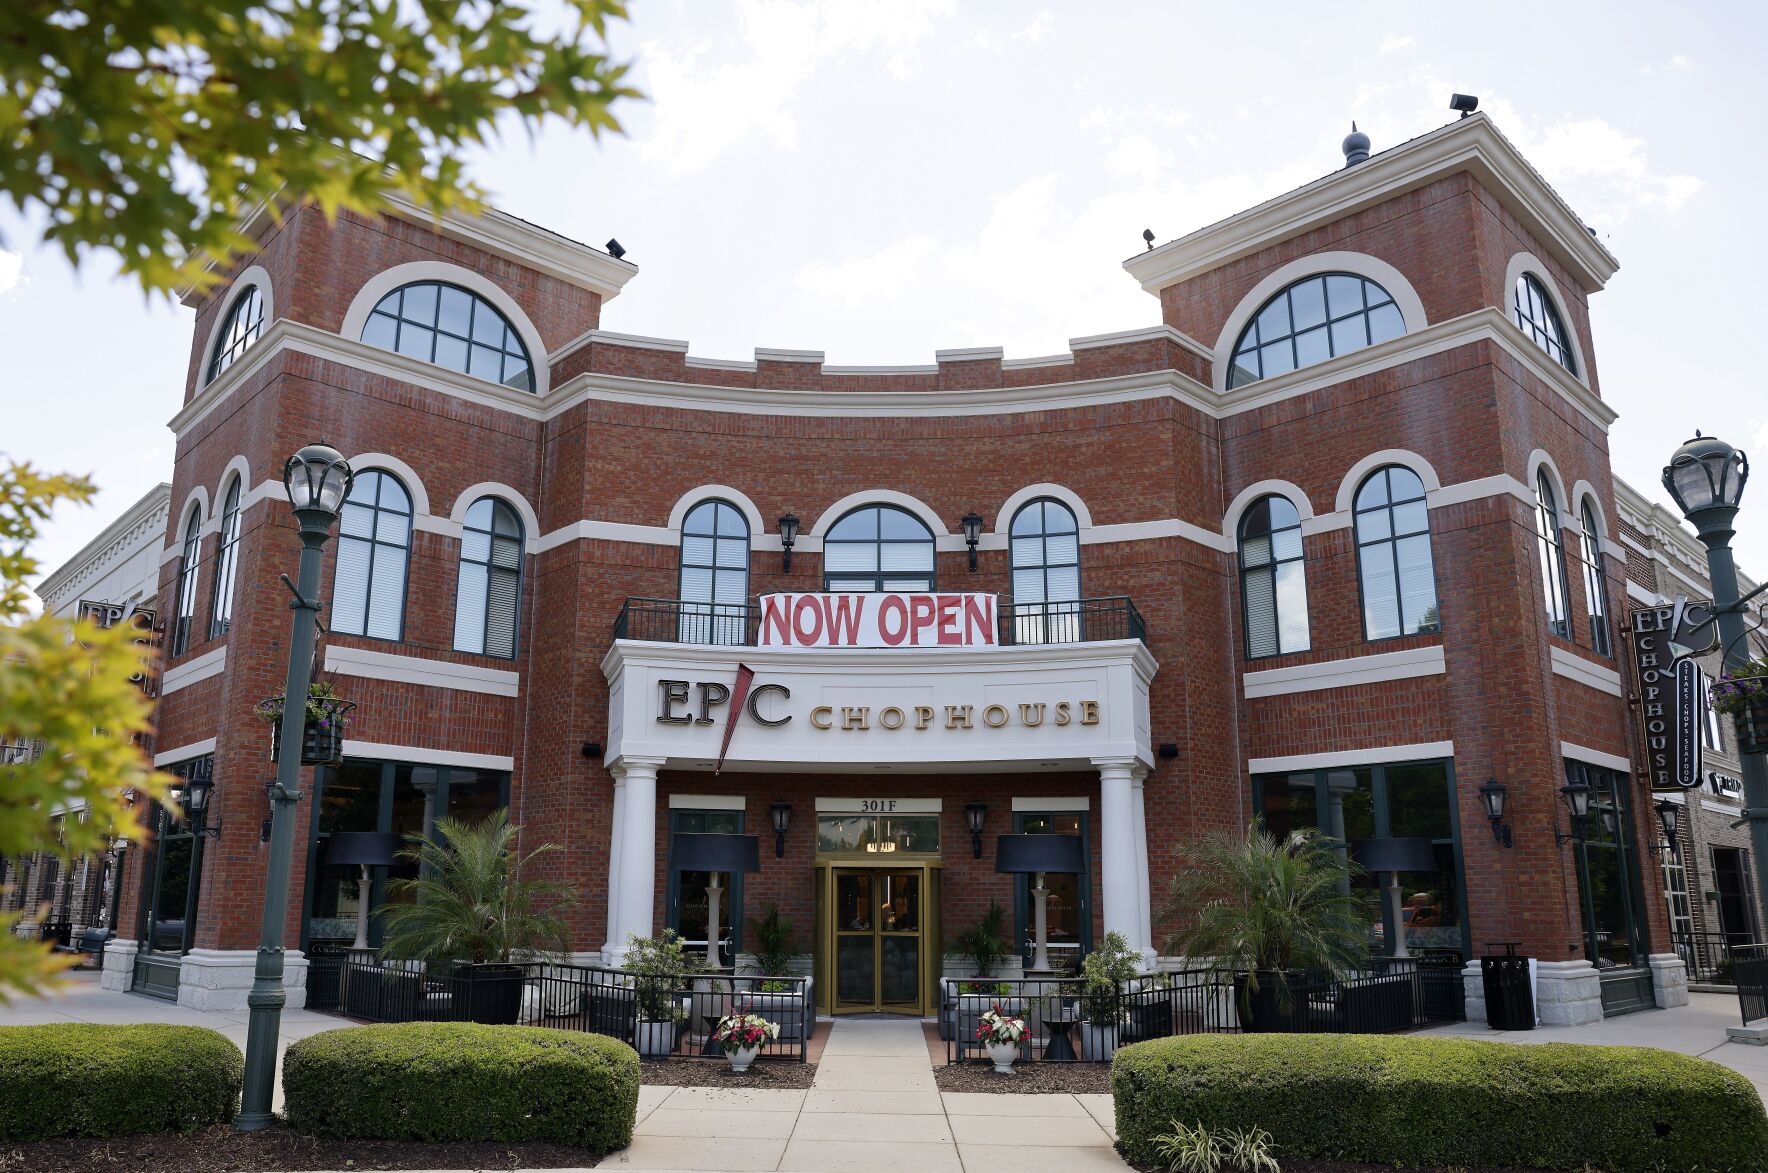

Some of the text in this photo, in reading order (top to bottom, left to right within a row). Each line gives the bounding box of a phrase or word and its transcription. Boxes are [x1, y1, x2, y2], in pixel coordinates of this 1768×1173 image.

[762, 595, 994, 646] NOW OPEN
[810, 700, 1099, 730] CHOPHOUSE
[1640, 636, 1669, 784] CHOPHOUSE
[861, 800, 897, 812] 301F
